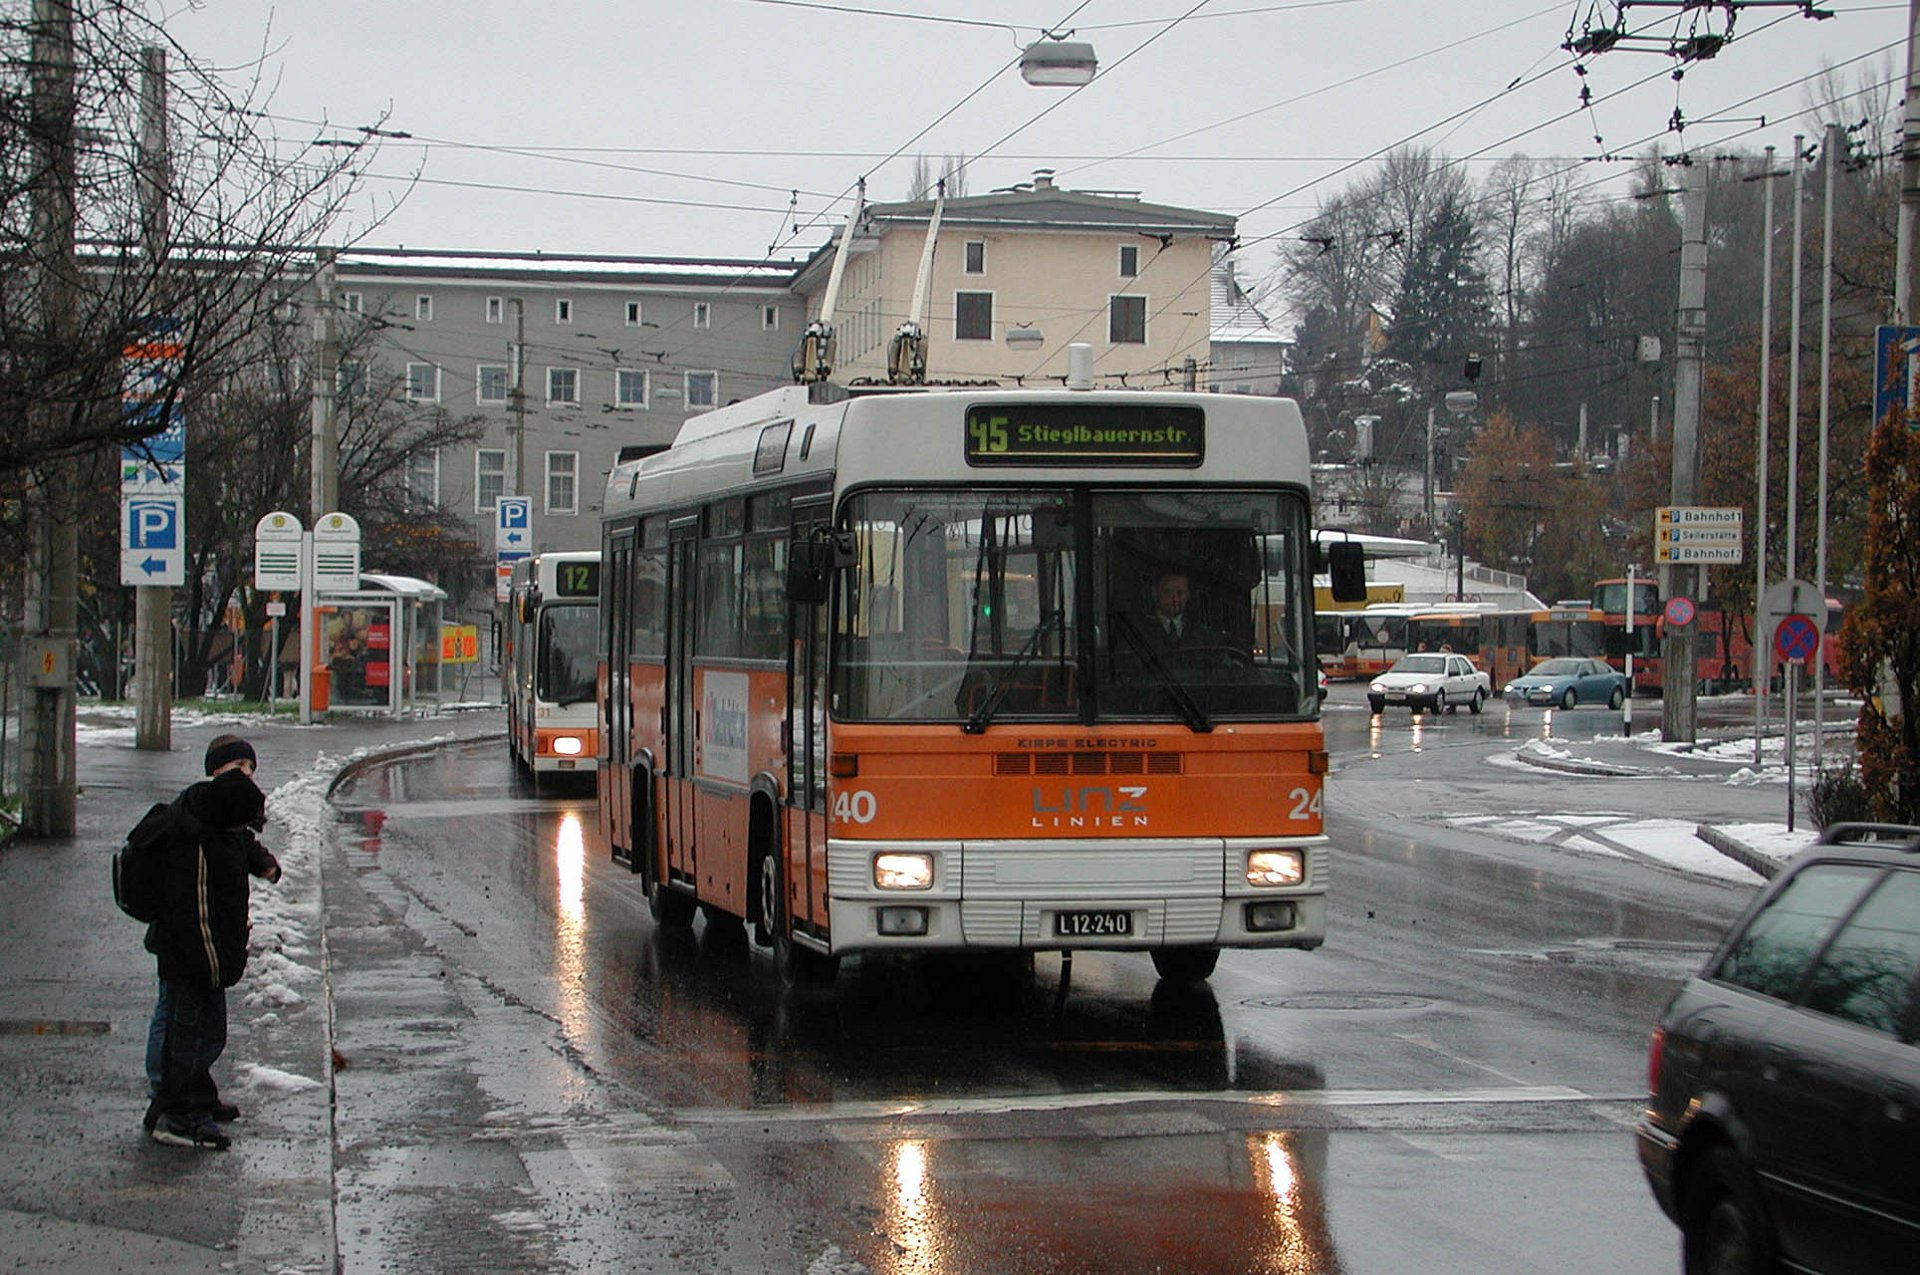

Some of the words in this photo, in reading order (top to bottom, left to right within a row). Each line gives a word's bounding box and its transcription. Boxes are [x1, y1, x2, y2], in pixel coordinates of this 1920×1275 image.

[970, 416, 1009, 452] 45
[1018, 424, 1193, 445] Stieglbauernstr.
[564, 565, 589, 590] 12
[1075, 738, 1157, 748] ELECTRIC
[831, 790, 877, 824] 40
[1032, 816, 1148, 827] LINIEN
